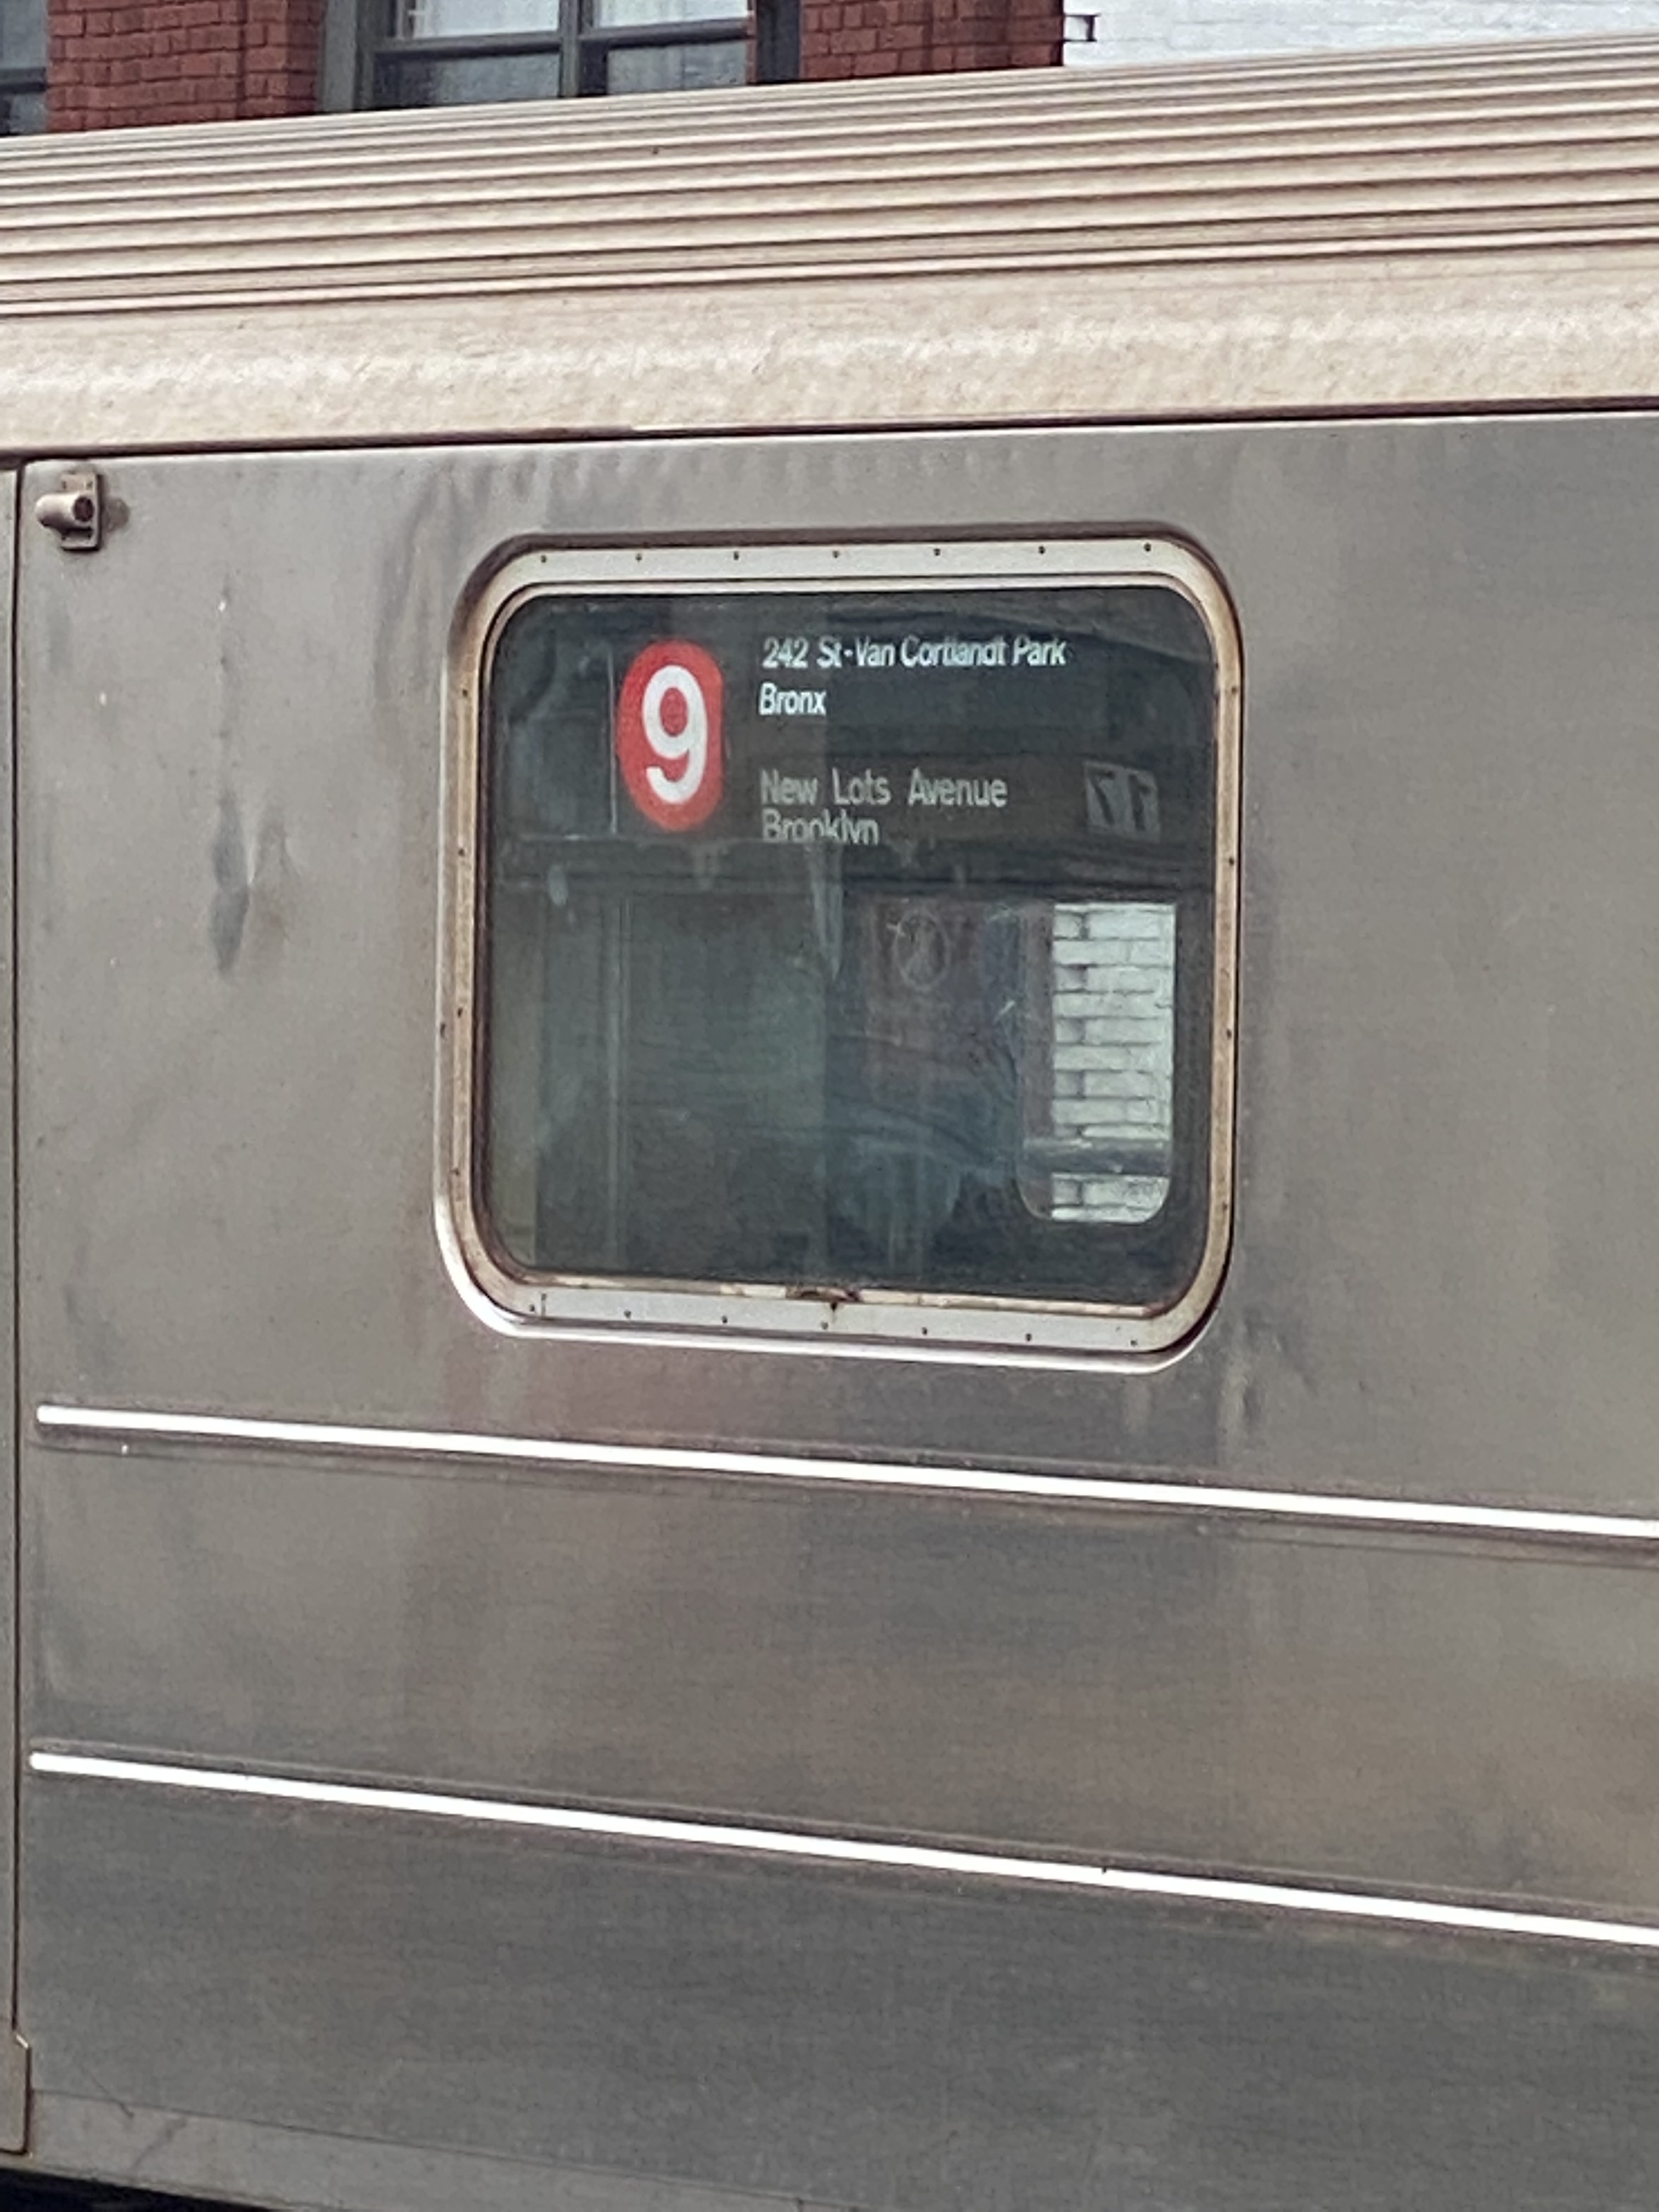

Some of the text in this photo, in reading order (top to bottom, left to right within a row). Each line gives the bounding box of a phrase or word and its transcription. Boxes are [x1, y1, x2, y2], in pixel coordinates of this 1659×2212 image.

[761, 635, 809, 668] 242
[901, 635, 1008, 667] Cortlandt
[1012, 635, 1066, 667] Park
[759, 682, 827, 715] Bronx
[642, 664, 708, 804] 9
[759, 767, 1008, 808] New Lots Avenue
